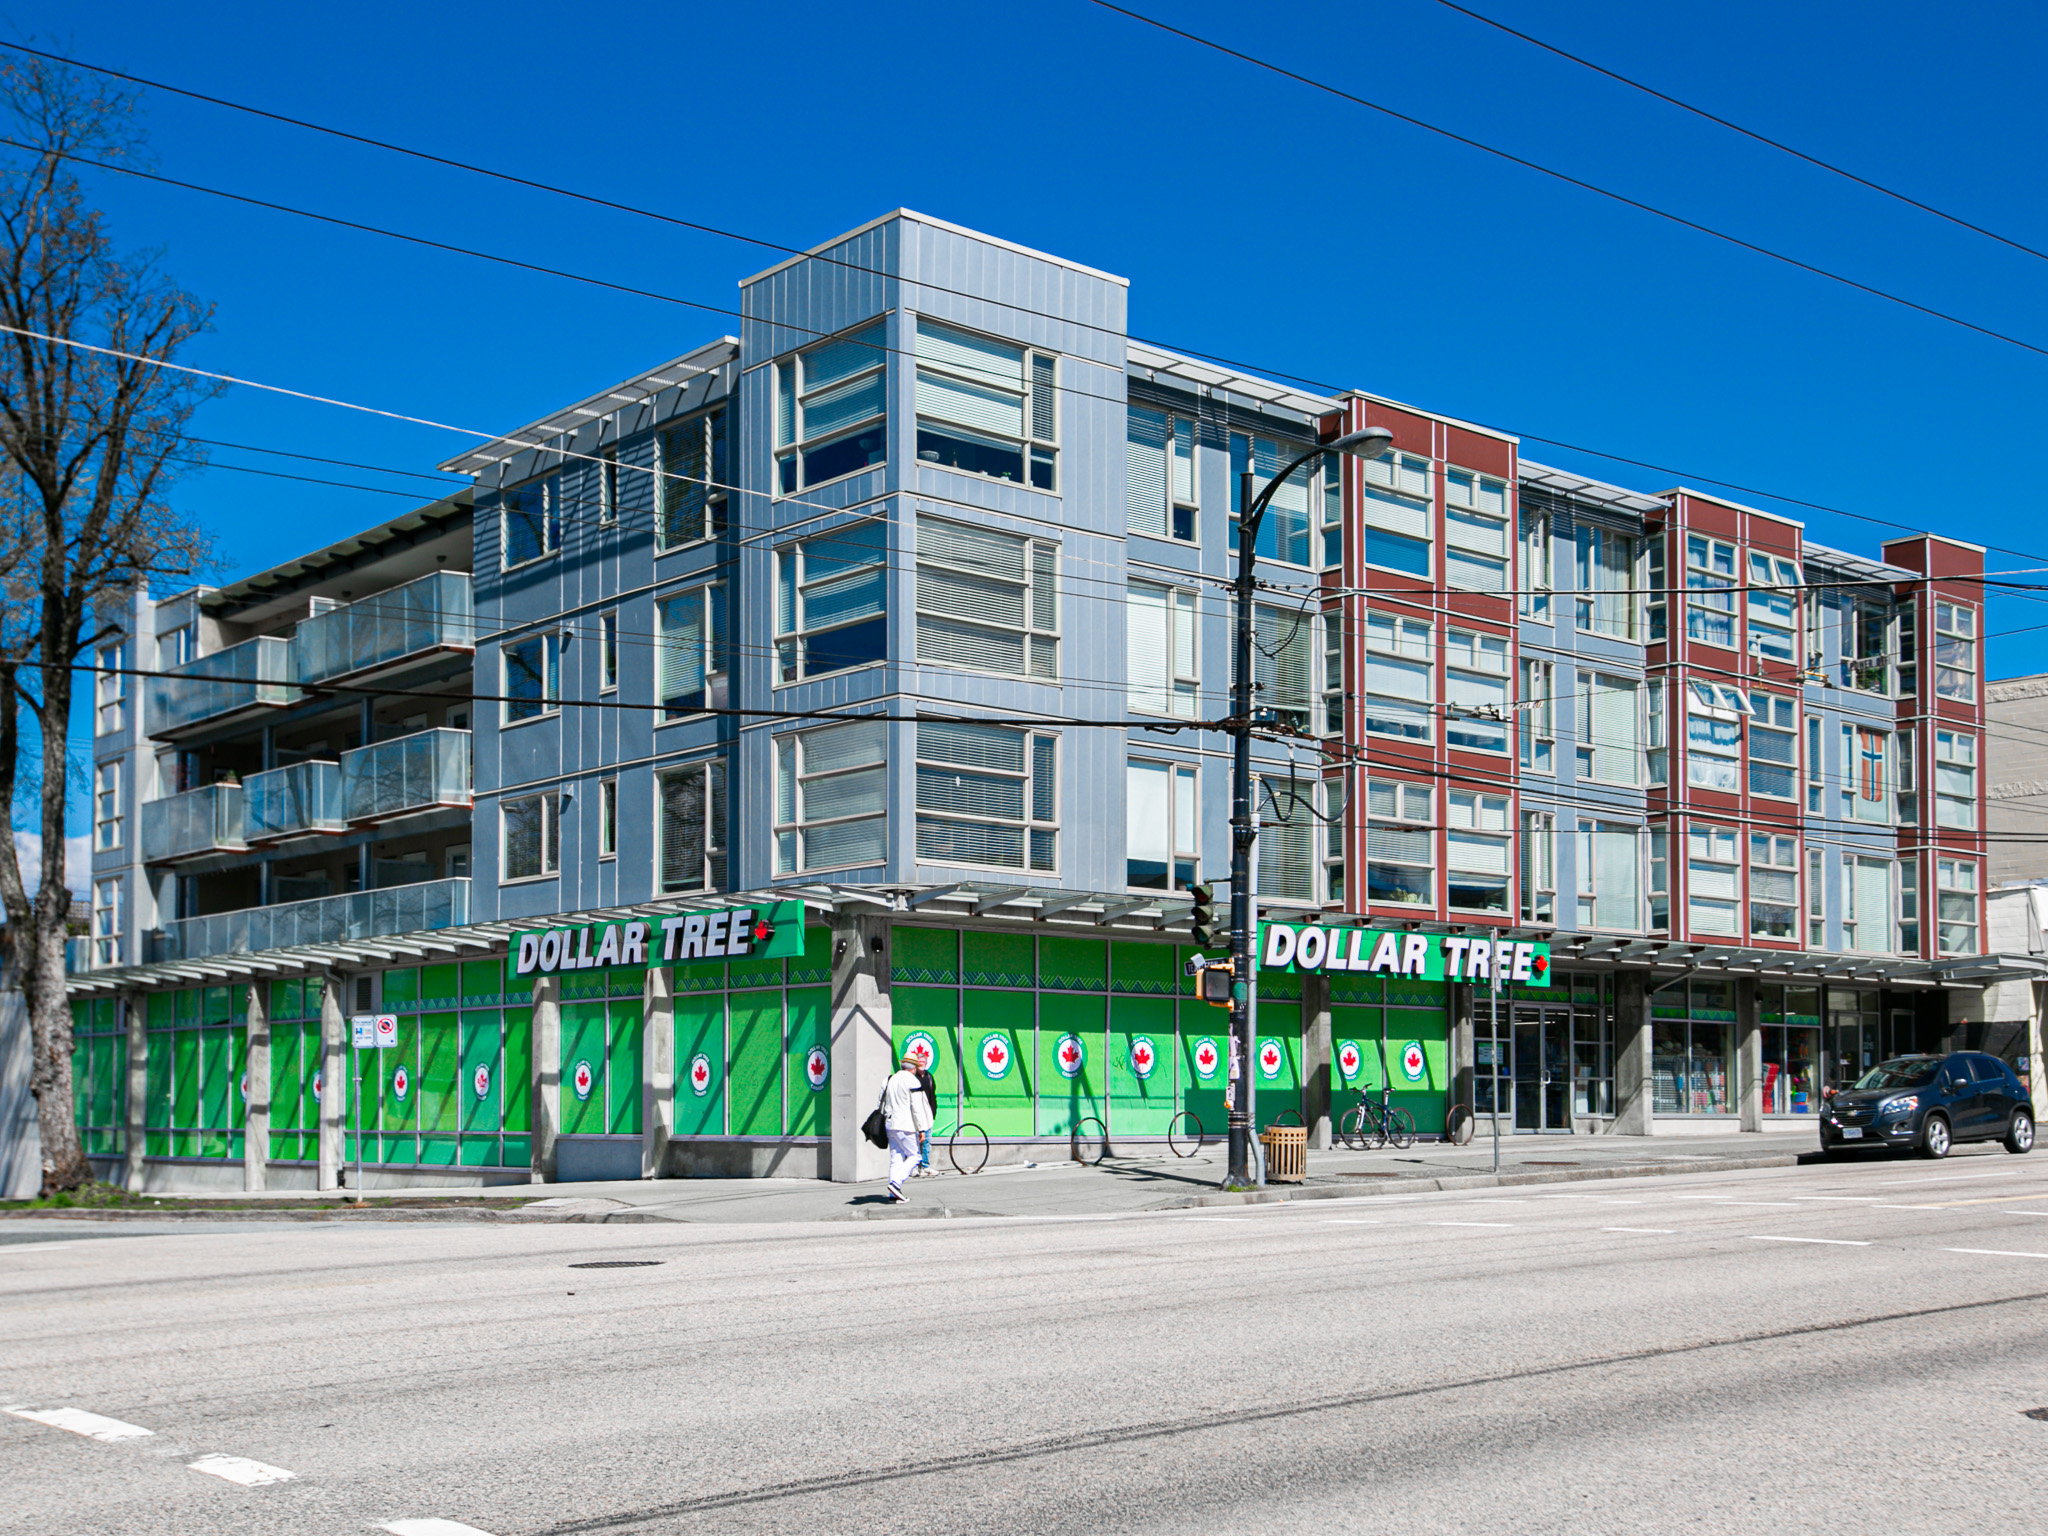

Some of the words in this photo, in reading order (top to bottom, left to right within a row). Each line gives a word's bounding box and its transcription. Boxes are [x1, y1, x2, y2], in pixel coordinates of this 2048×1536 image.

[517, 921, 646, 974] DOLLAR
[661, 909, 753, 960] TREE
[1264, 924, 1428, 974] DOLLAR
[1444, 937, 1535, 981] TREE
[906, 1032, 922, 1043] DOLLAR
[923, 1033, 934, 1043] TREE
[982, 1033, 998, 1045] DOLLAR
[999, 1035, 1009, 1045] TREE
[1195, 1038, 1208, 1047] DOLLAR
[1209, 1038, 1218, 1047] TREE
